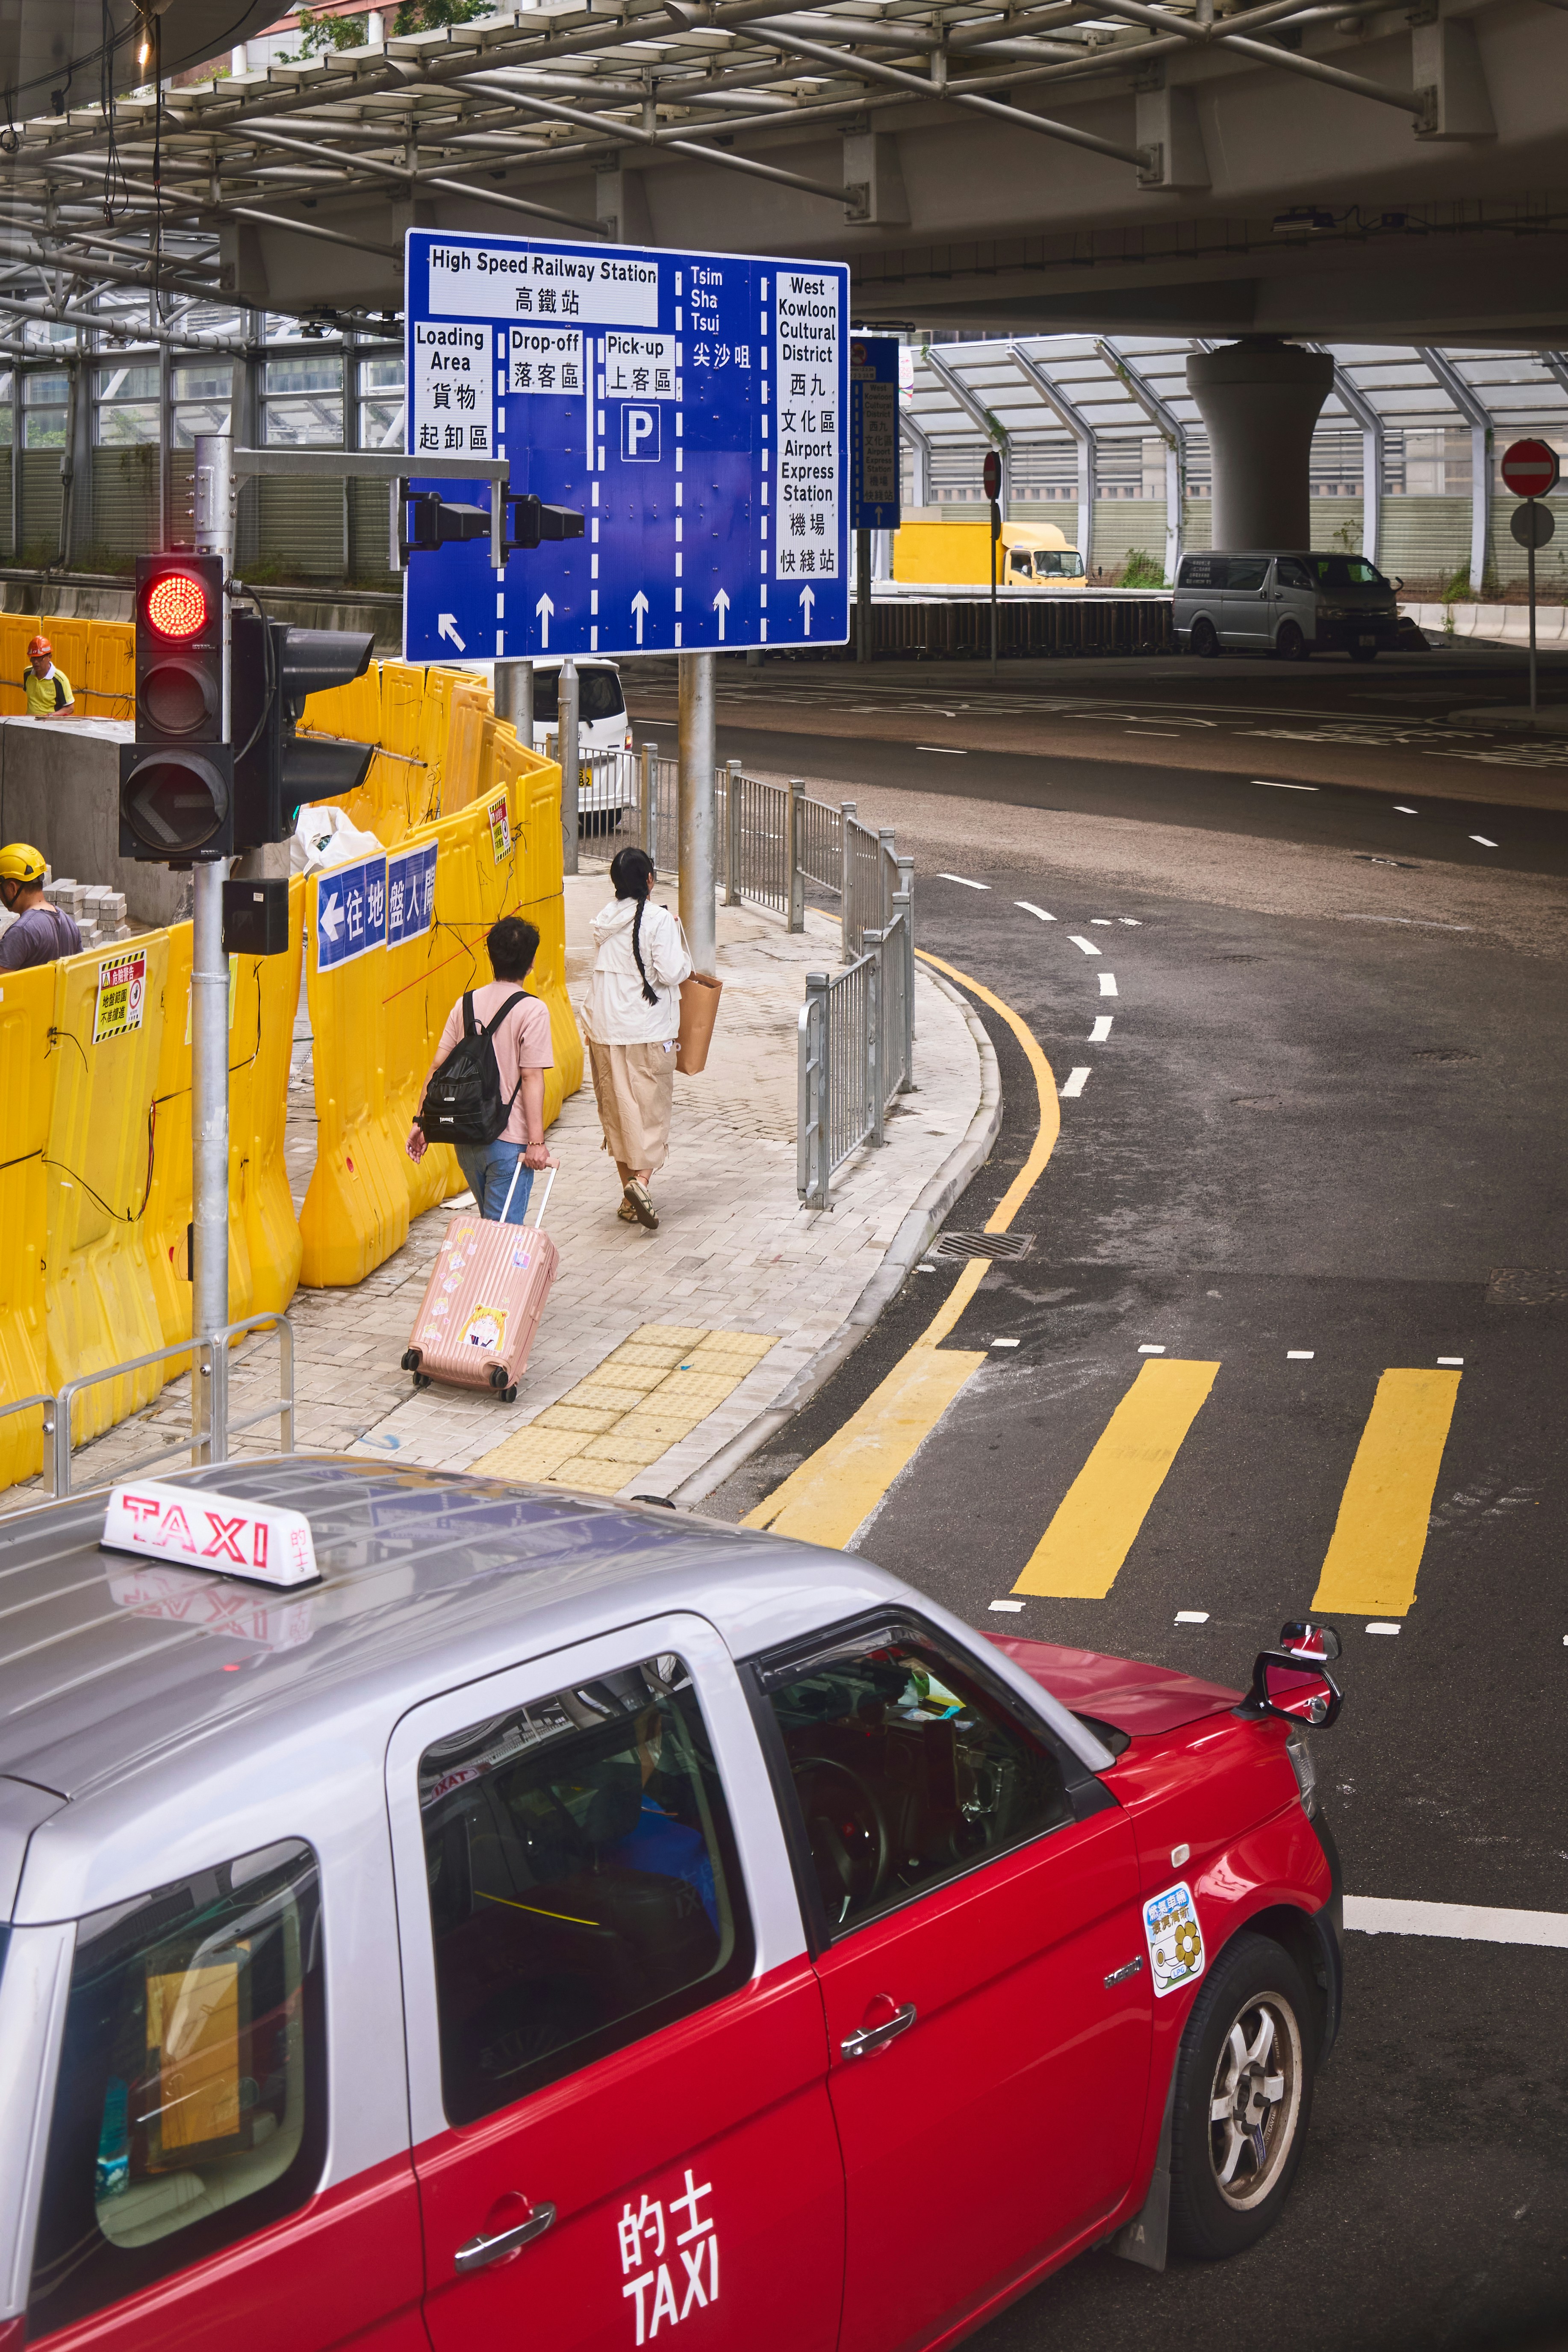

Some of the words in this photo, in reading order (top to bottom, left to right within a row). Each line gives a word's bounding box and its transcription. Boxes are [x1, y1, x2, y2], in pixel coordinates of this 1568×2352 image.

[433, 249, 471, 273] High
[477, 252, 528, 275] Speed
[532, 257, 596, 282] Railway
[600, 260, 657, 283] Station
[690, 266, 722, 286] Tsim
[791, 277, 825, 295] West
[516, 286, 579, 315] 高鐵站
[691, 289, 718, 309] Sha
[779, 298, 836, 318] Kowloon
[691, 312, 719, 331] Tsui
[780, 321, 836, 341] Cultural
[417, 325, 483, 351] Loading
[512, 330, 579, 354] Drop-off
[608, 336, 664, 358] Pick-up
[430, 351, 471, 371] Area
[693, 342, 751, 369] 尖沙咀
[783, 344, 832, 363] District
[514, 362, 578, 389] 落客區
[610, 366, 671, 392] 上客區
[790, 373, 825, 396] 西九
[432, 383, 475, 410] 貨物
[781, 409, 835, 433] 文化區
[869, 421, 888, 432] 西九
[419, 423, 488, 451] 起卸區
[628, 410, 653, 455] P
[865, 435, 893, 446] 文化區
[784, 439, 832, 460] Airport
[867, 448, 890, 457] Airport
[782, 462, 834, 482] Express
[783, 484, 832, 501] Station
[790, 513, 825, 536] 機場
[780, 548, 834, 573] 快綫站
[112, 966, 134, 986] 危險警告
[103, 989, 127, 1008] 地盤範圍
[123, 1494, 268, 1569] TAXI
[290, 1528, 308, 1568] 的士
[1173, 1966, 1185, 1978] LPG
[617, 2169, 713, 2275] 的士
[622, 2234, 719, 2346] TAXI
